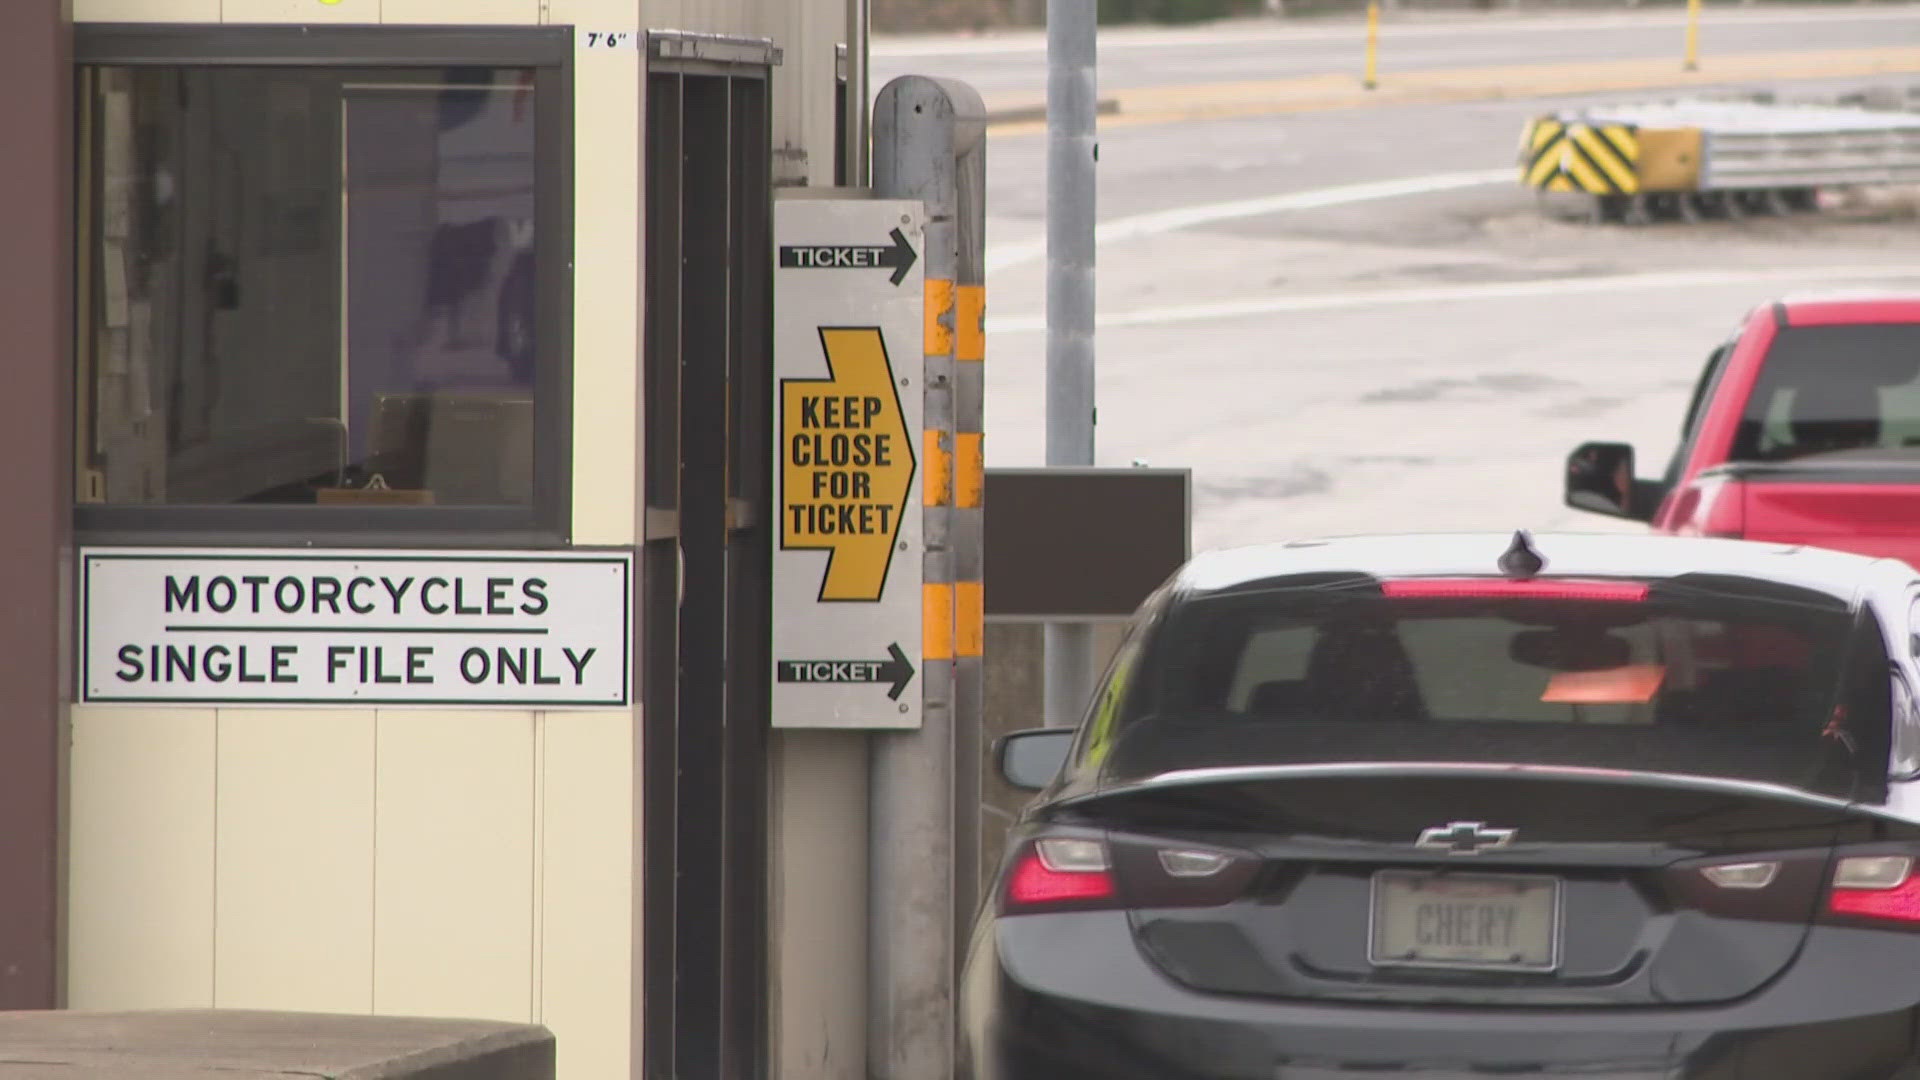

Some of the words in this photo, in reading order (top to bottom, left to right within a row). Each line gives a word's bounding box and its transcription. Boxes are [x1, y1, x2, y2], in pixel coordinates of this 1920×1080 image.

[792, 247, 885, 267] TICKET
[801, 396, 882, 429] KEEP
[791, 433, 892, 467] CLOSE
[812, 471, 871, 499] FOR
[788, 503, 894, 535] TICKET
[165, 575, 549, 616] MOTORCYCLES
[115, 643, 299, 683] SINGLE
[327, 645, 434, 684] FILE
[459, 646, 597, 685] ONLY
[790, 662, 882, 681] TICKET
[1415, 903, 1517, 947] CHERY
